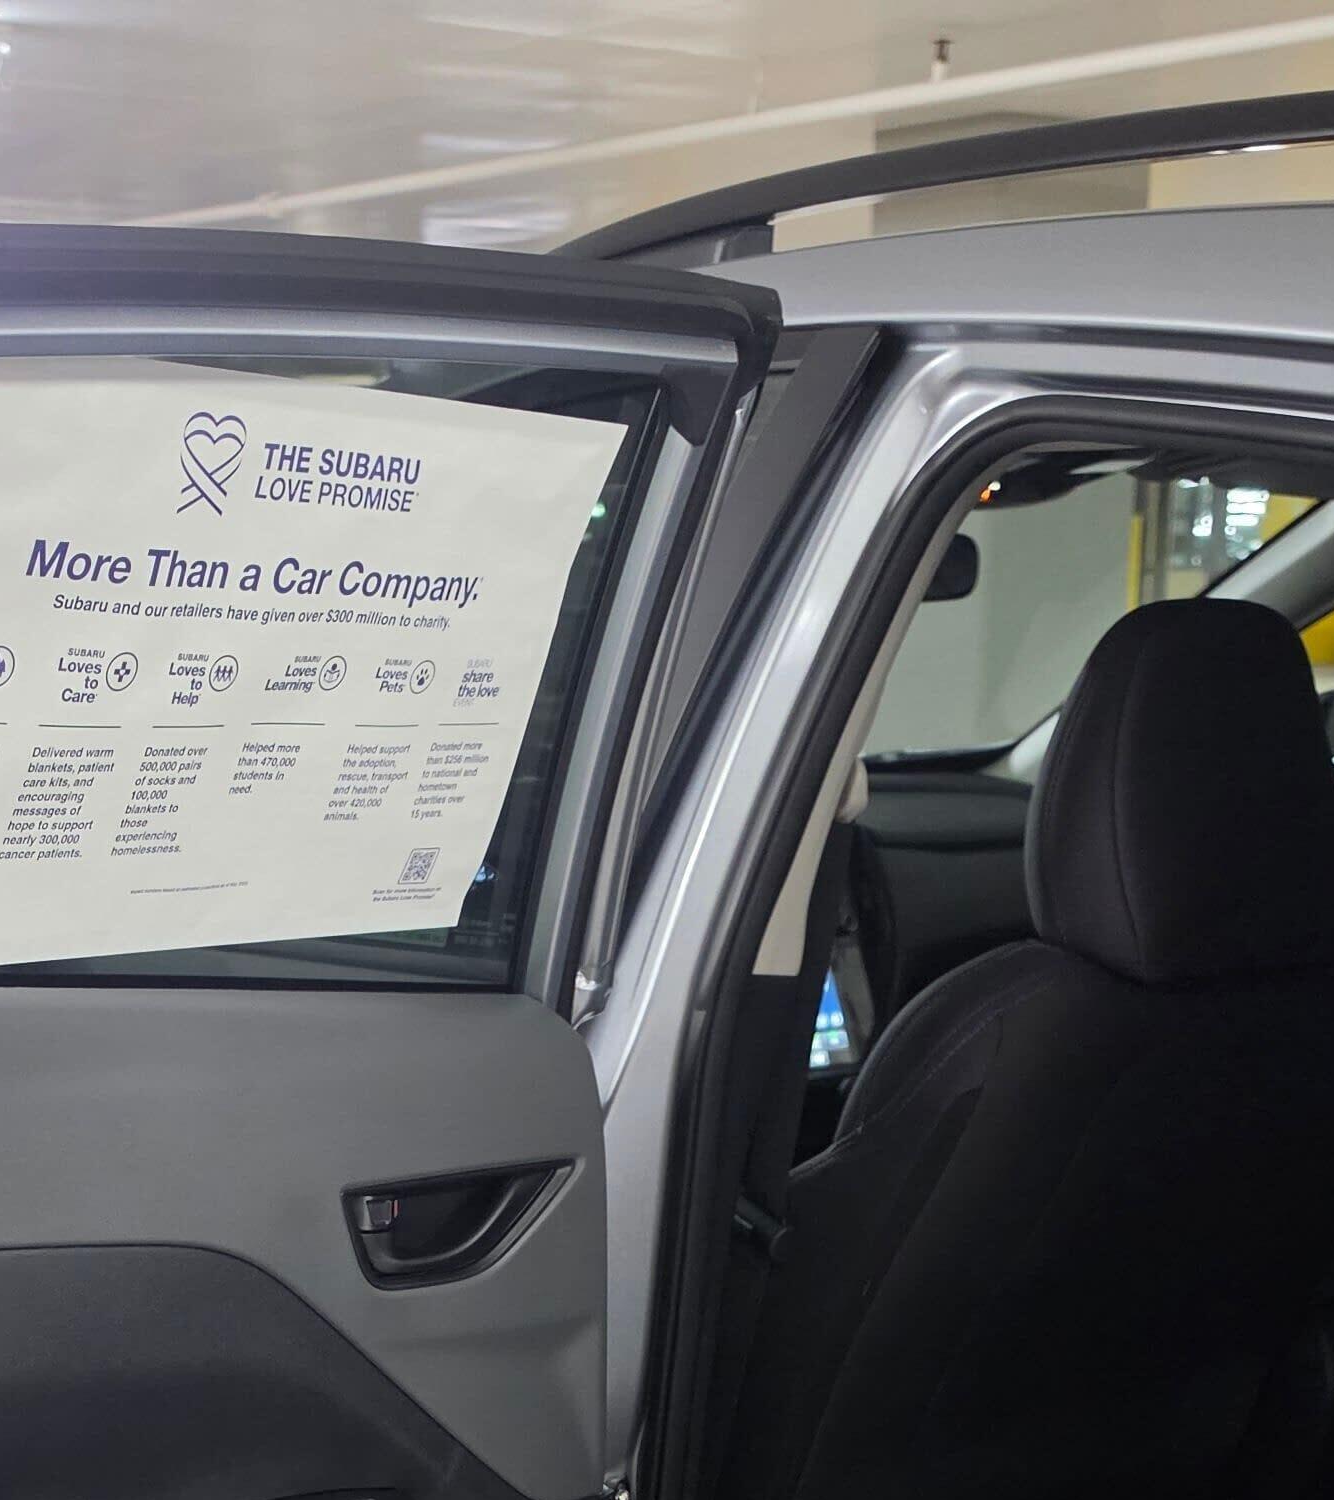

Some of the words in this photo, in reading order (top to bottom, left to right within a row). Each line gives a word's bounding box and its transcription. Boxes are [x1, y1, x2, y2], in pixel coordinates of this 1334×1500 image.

[264, 443, 314, 473] THE
[319, 449, 420, 485] SUBARU
[254, 476, 313, 503] LOVE
[318, 482, 414, 512] PROMISE
[25, 539, 132, 584] More
[147, 548, 229, 589] Than
[239, 563, 261, 593] a
[273, 557, 332, 595] Car
[338, 560, 479, 608] Company.
[53, 594, 108, 614] Subaru
[112, 599, 141, 616] and
[144, 604, 168, 617] our
[171, 603, 223, 620] retailers
[227, 605, 258, 622] have
[261, 609, 295, 626] given
[298, 611, 323, 623] over
[325, 608, 353, 625] $300
[356, 611, 396, 627] million
[399, 613, 411, 628] to
[413, 614, 450, 631] charity.
[68, 648, 106, 659] SUBARU
[178, 653, 209, 662] SUBARU
[58, 657, 102, 674] Loves
[169, 663, 206, 677] Loves
[285, 665, 317, 677] Loves
[376, 667, 408, 680] Loves
[462, 670, 494, 683] share
[84, 676, 99, 689] to
[190, 679, 202, 690] to
[265, 679, 313, 693] Learning
[379, 681, 404, 693] Pets
[61, 689, 96, 703] Care
[458, 684, 477, 697] the
[477, 683, 500, 698] love
[171, 692, 199, 707] Help
[32, 747, 83, 758] Delivered
[86, 749, 114, 758] warm
[144, 747, 185, 757] Donated
[187, 748, 208, 756] over
[242, 742, 275, 754] Helped
[277, 744, 300, 753] more
[347, 744, 378, 755] Helped
[379, 744, 410, 755] support
[463, 742, 482, 751] more
[28, 762, 75, 774] blankets,
[77, 762, 114, 775] patient
[139, 761, 177, 773] 500,000
[178, 761, 202, 772] pairs
[237, 757, 258, 767] than
[260, 757, 296, 768] 470,000
[343, 759, 356, 768] the
[135, 776, 145, 786] of
[147, 775, 176, 786] socks
[178, 775, 196, 785] and
[233, 771, 273, 781] students
[275, 771, 284, 781] in
[371, 772, 408, 782] transport
[23, 778, 46, 788] care
[49, 777, 70, 788] kits,
[73, 777, 94, 787] and
[131, 790, 167, 801] 100,000
[229, 785, 252, 795] need.
[333, 786, 350, 795] and
[352, 785, 377, 794] health
[379, 785, 389, 794] of
[17, 792, 85, 804] encouraging
[328, 799, 347, 807] over
[12, 807, 67, 818] messages
[70, 806, 81, 816] of
[125, 804, 166, 814] blankets
[169, 804, 179, 813] to
[7, 820, 34, 833] hope
[38, 821, 48, 831] to
[51, 820, 93, 832] support
[120, 819, 148, 828] those
[3, 835, 37, 847] nearly
[39, 834, 80, 845] 300,000
[115, 832, 177, 842] experiencing
[37, 848, 82, 860] patients.
[111, 844, 181, 856] homelessness.
